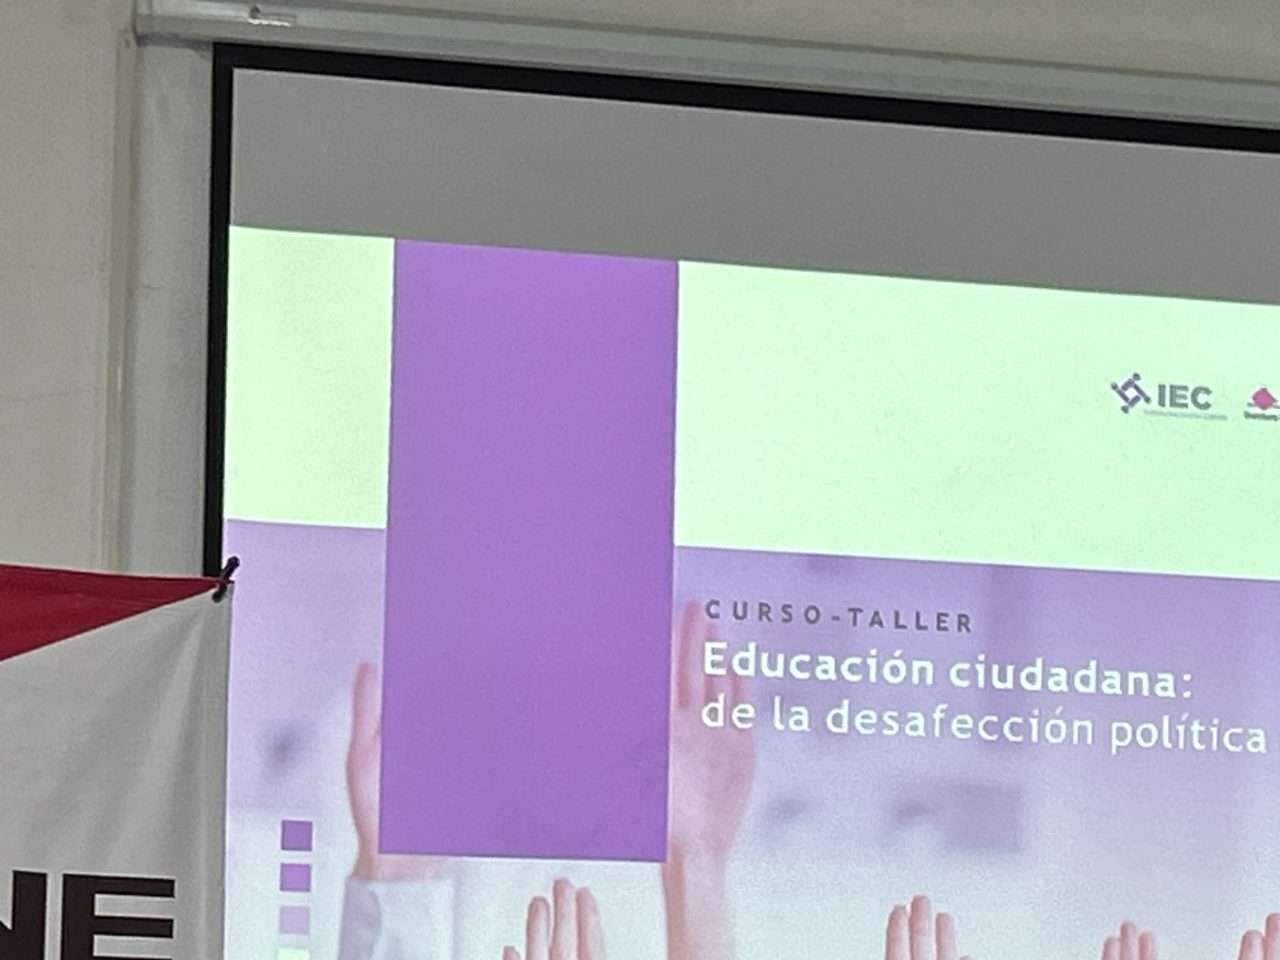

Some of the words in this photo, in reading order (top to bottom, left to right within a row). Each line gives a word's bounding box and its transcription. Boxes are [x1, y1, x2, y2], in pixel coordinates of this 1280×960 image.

[1158, 384, 1212, 411] IEC
[705, 599, 973, 633] CURSO-TALLER
[703, 640, 934, 686] Educación
[949, 654, 1194, 699] ciudadana:
[701, 694, 756, 730] de
[772, 697, 811, 733] la
[826, 699, 1093, 745] desafección
[1110, 712, 1267, 754] política
